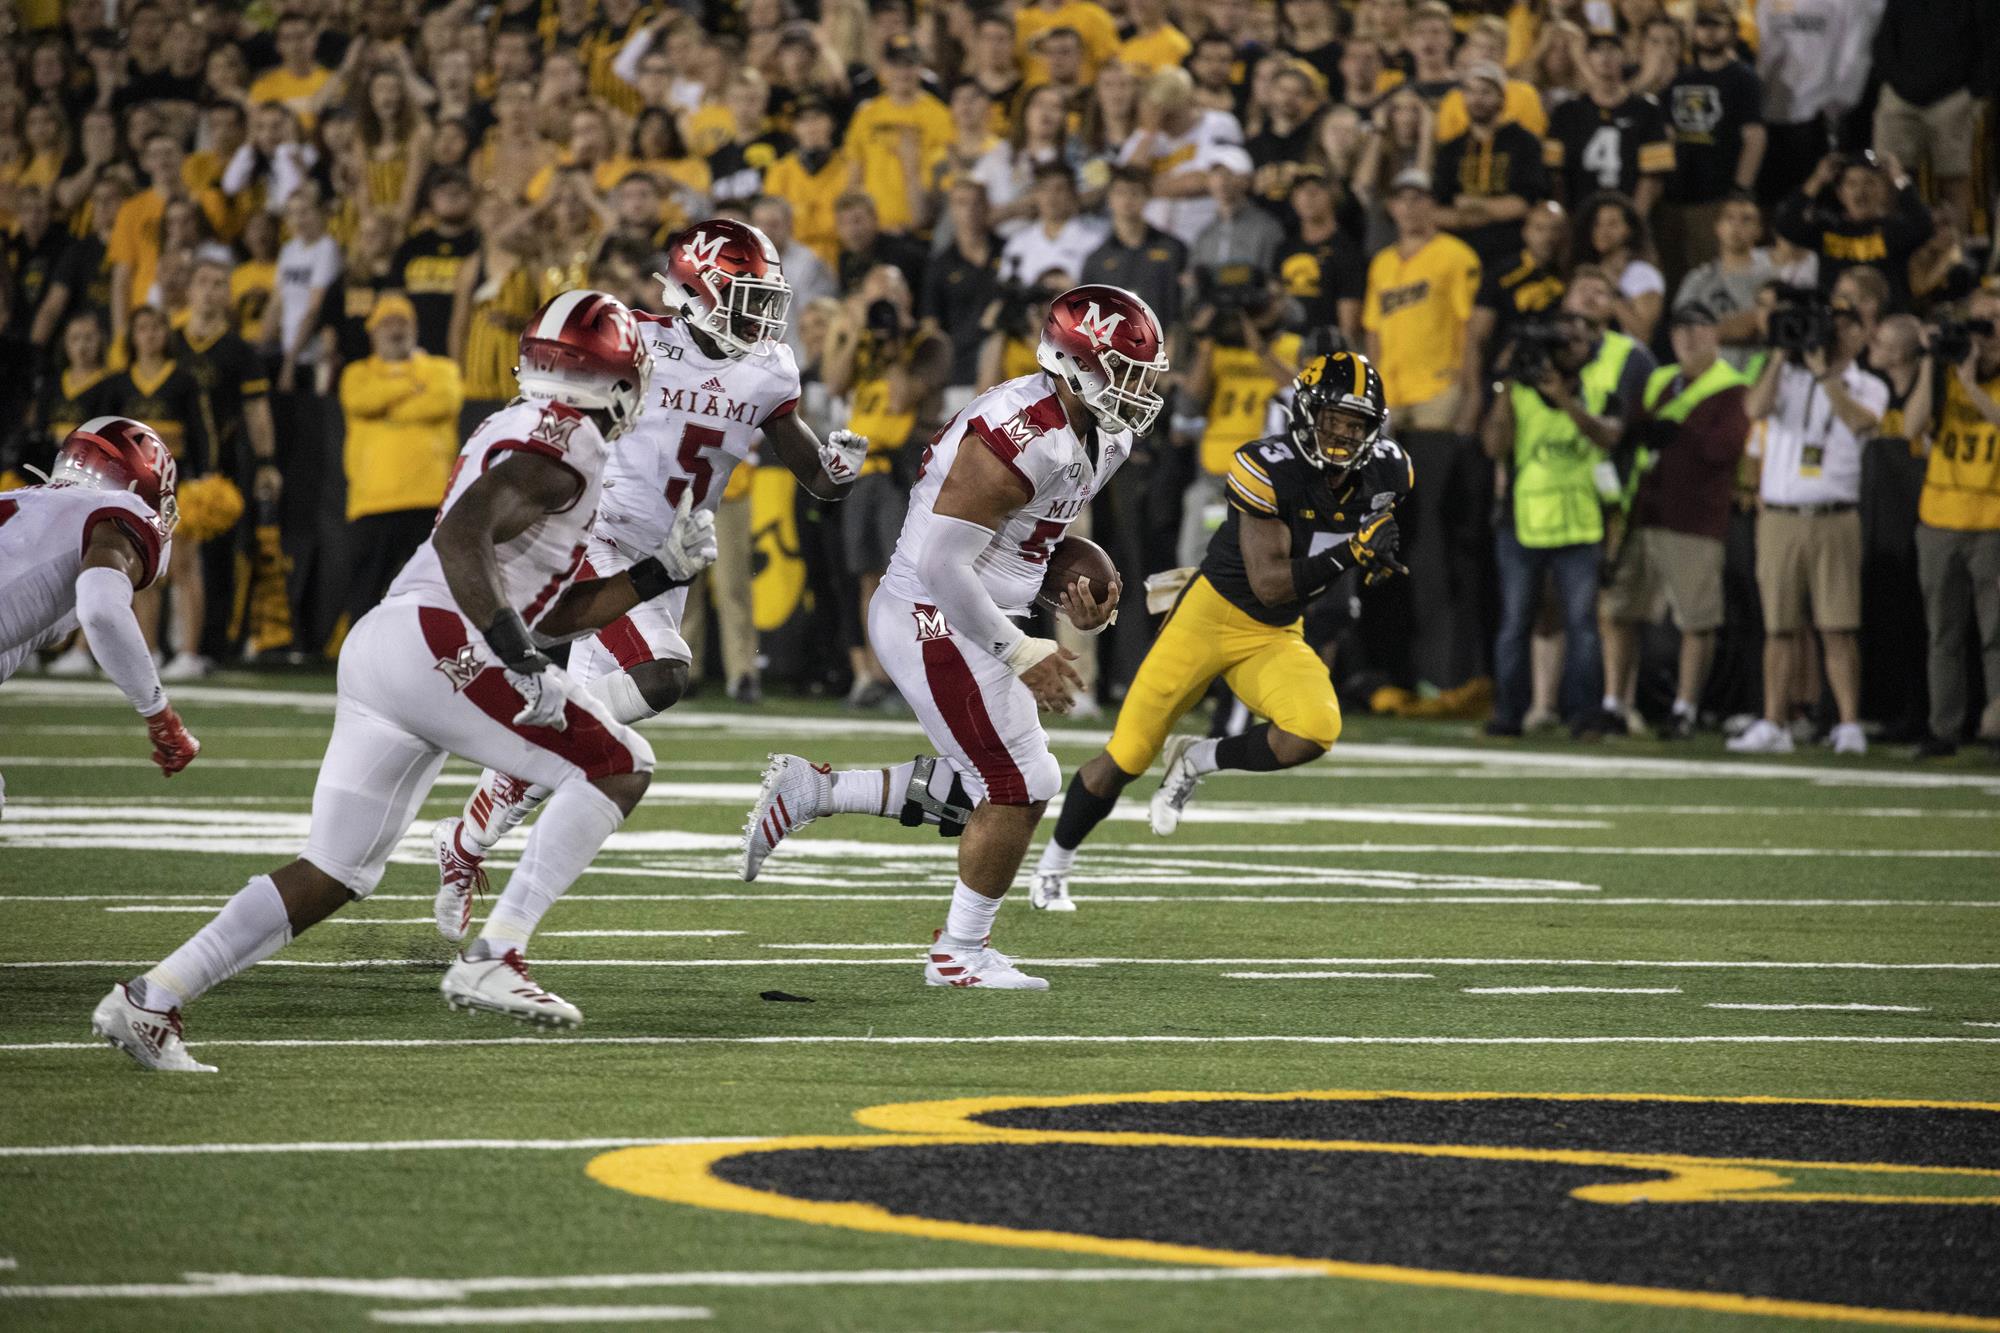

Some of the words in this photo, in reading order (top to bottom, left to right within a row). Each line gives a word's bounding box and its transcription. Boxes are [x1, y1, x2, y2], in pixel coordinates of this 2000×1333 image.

[1582, 125, 1622, 188] 4
[681, 231, 732, 271] M
[1074, 301, 1126, 348] M
[660, 387, 760, 426] MIAMI
[701, 382, 727, 394] adidas
[1000, 408, 1044, 453] M
[664, 422, 727, 512] 5
[1259, 442, 1296, 464] 3
[911, 609, 954, 642] M
